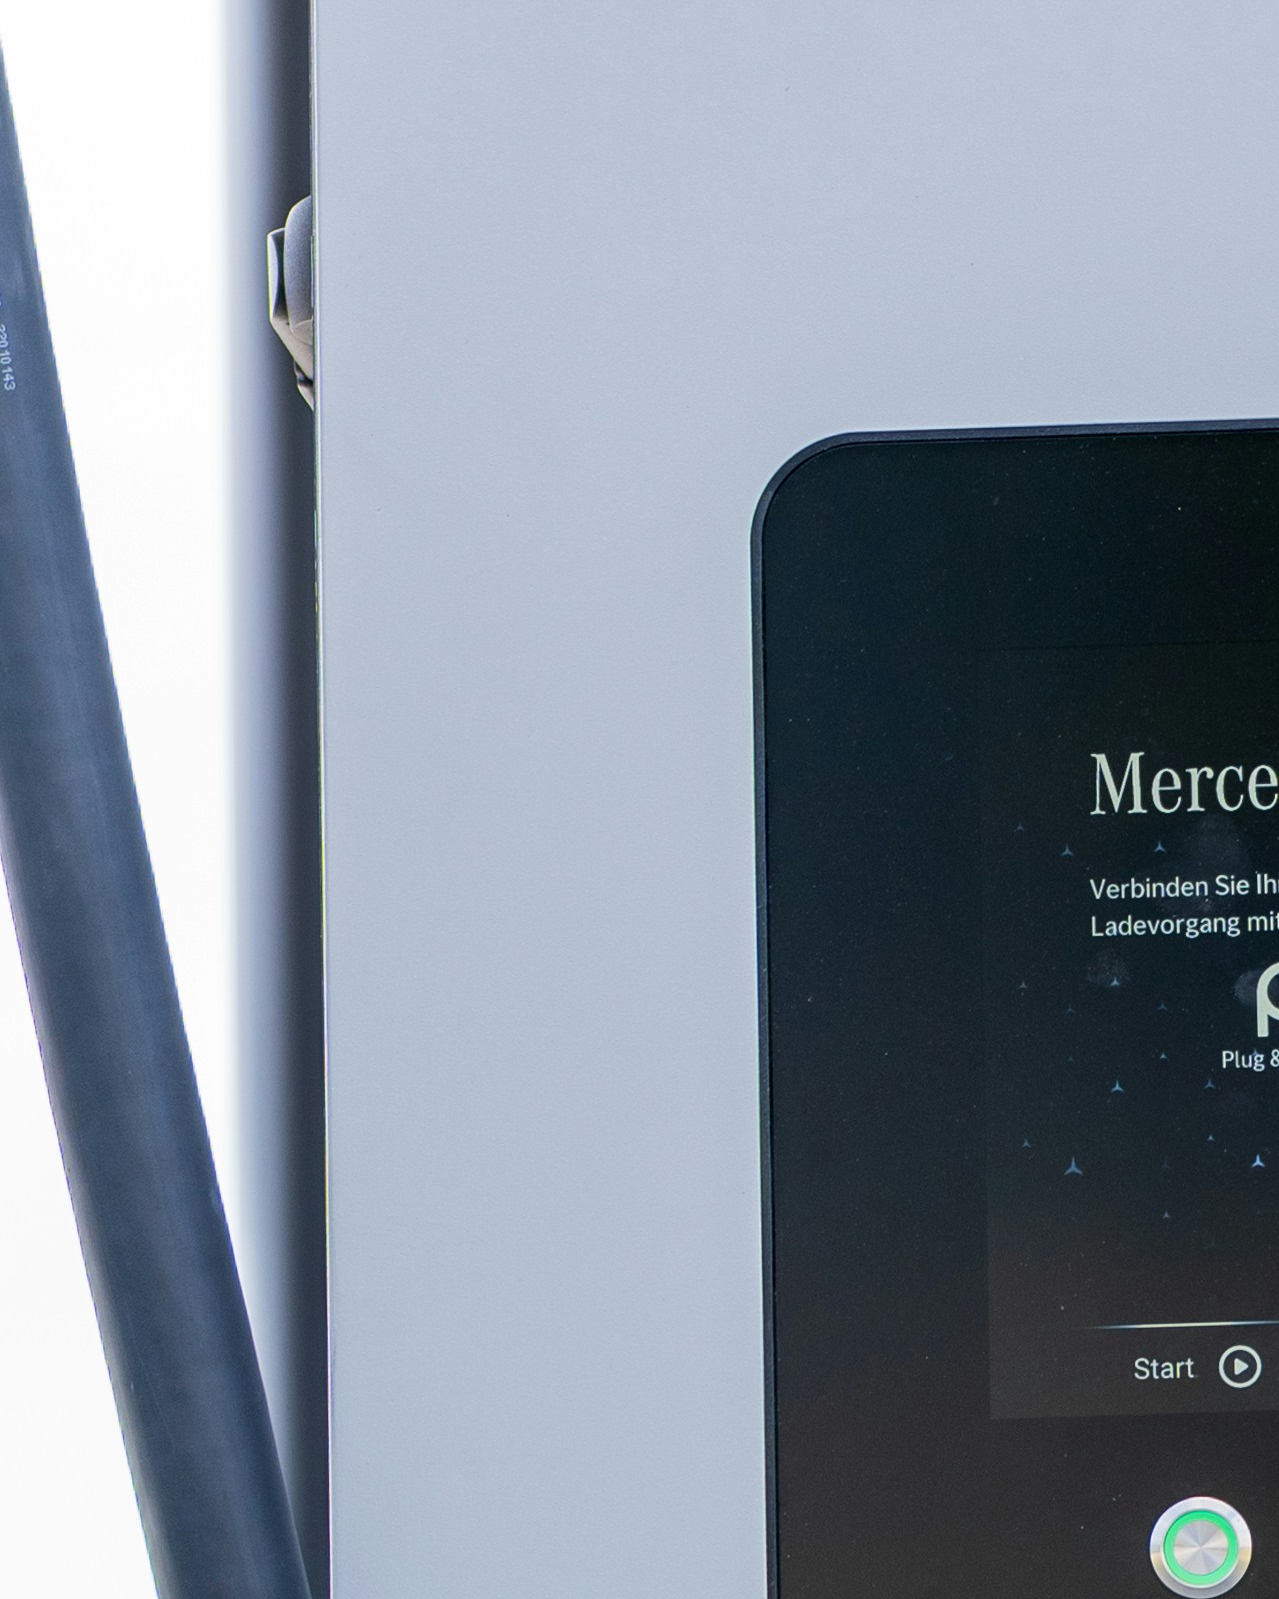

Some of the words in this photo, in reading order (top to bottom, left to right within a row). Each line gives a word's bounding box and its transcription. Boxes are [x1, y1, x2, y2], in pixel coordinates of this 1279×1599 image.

[1089, 875, 1209, 902] Verbinden
[1215, 874, 1250, 896] Sie
[1091, 914, 1241, 939] Ladevorgang
[1222, 1050, 1266, 1072] Plug
[1134, 1357, 1195, 1380] Start
